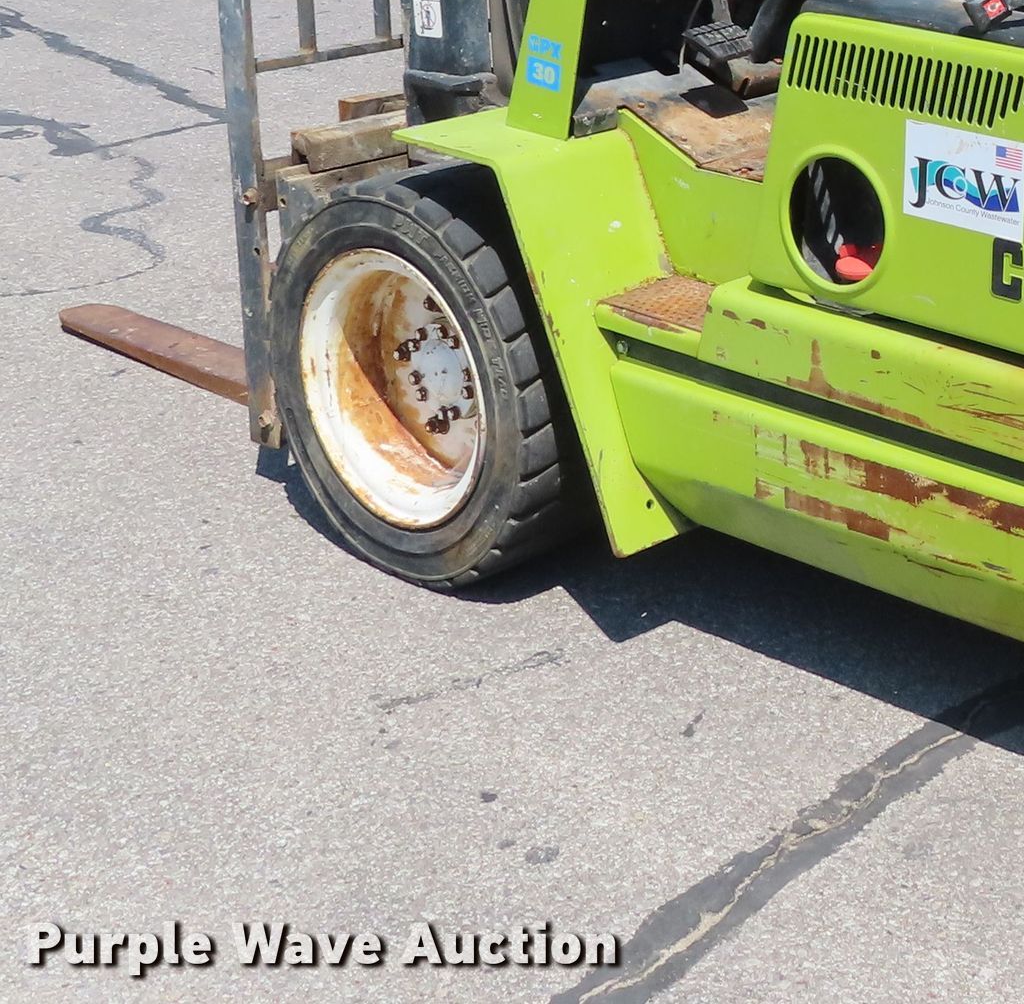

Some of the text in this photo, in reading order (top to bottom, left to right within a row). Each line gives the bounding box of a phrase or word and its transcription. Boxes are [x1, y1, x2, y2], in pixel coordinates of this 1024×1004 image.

[532, 61, 556, 85] 30
[926, 198, 1020, 226] Johnson County Wastewater
